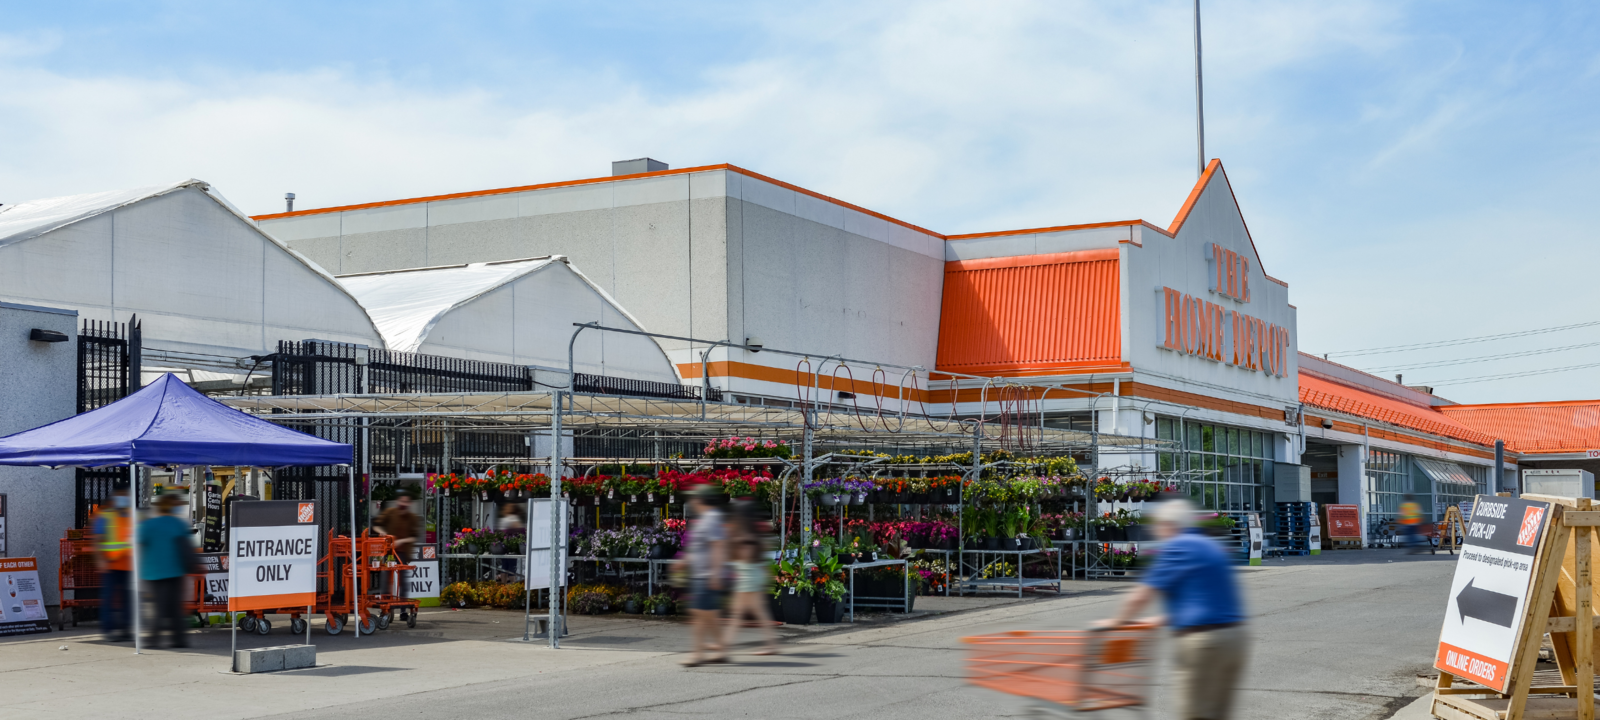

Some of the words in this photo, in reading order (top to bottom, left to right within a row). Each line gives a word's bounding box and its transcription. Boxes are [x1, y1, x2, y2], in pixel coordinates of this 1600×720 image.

[1209, 243, 1250, 303] THE
[1160, 286, 1226, 363] HOME
[1231, 310, 1290, 379] DEPOT
[1588, 450, 1600, 458] TO
[1476, 501, 1508, 519] CURBSIDE
[1469, 522, 1496, 540] PICK-UP
[236, 538, 312, 558] ENTRANCE
[1463, 550, 1478, 561] Proceed
[1478, 553, 1482, 562] to
[1482, 553, 1504, 566] designated
[1503, 558, 1519, 571] pick-up
[1519, 562, 1528, 571] area
[256, 564, 292, 582] ONLY
[409, 581, 433, 593] NLY
[1446, 650, 1470, 672] ONLINE
[1469, 658, 1496, 681] ORDERS
